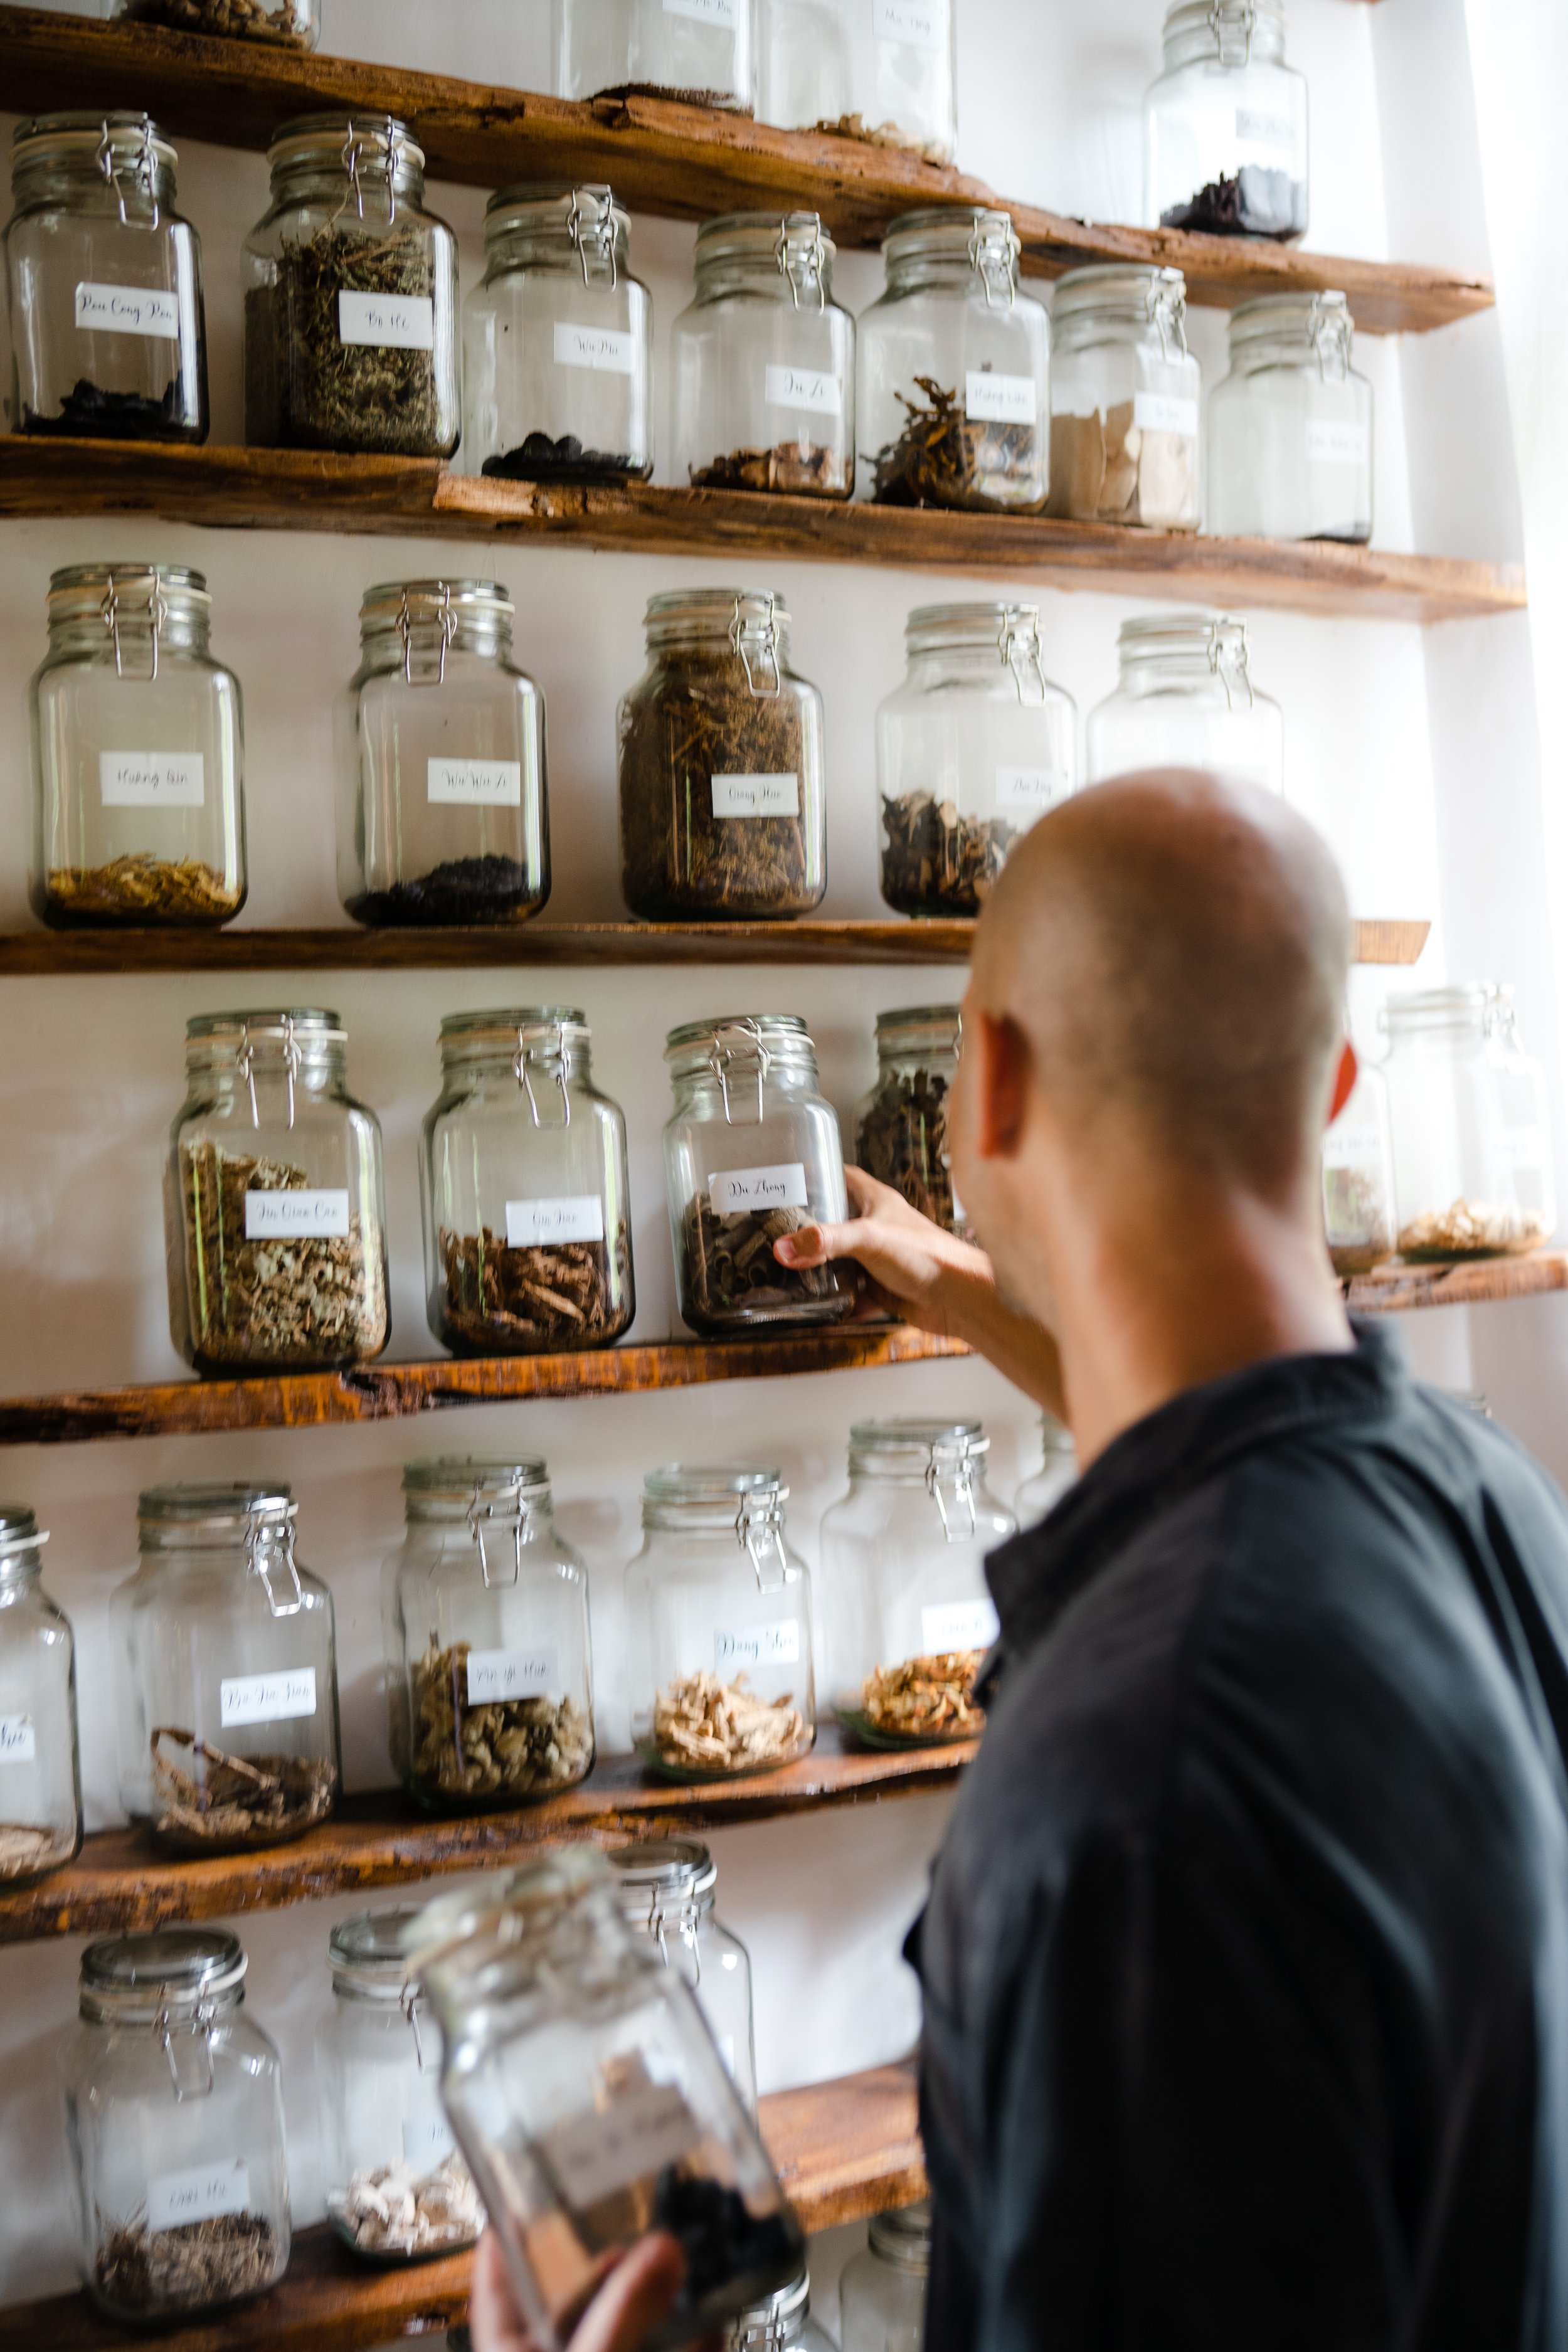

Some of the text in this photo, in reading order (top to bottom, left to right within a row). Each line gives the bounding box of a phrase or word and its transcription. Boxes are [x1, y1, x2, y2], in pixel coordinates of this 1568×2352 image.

[117, 767, 160, 790] Huang
[728, 1178, 786, 1199] Du Zhong
